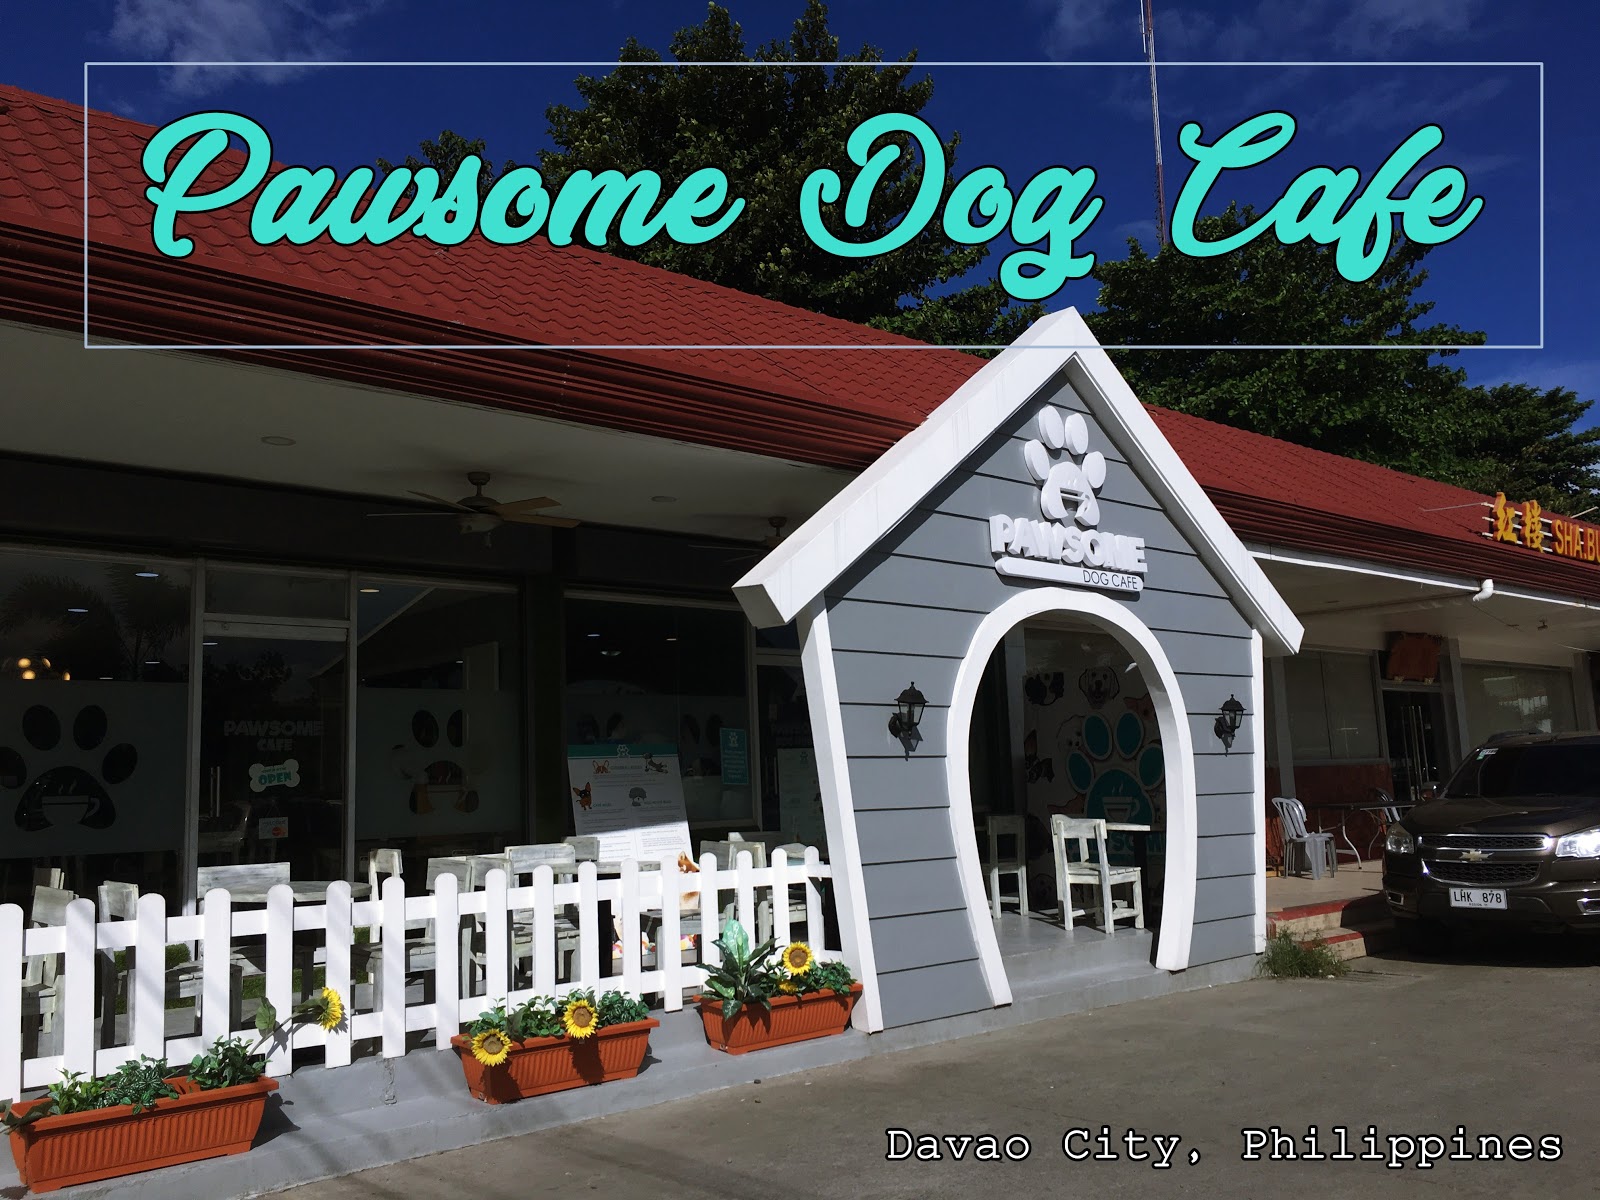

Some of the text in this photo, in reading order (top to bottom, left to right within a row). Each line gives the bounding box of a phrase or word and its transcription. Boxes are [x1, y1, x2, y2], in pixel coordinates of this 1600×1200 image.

[989, 514, 1148, 572] PAWSOME
[1082, 569, 1138, 590] DOG CAFE
[223, 719, 323, 736] PAWSOME
[256, 738, 294, 752] CAFE
[258, 771, 292, 786] OPEN
[1453, 891, 1502, 904] LHK 878
